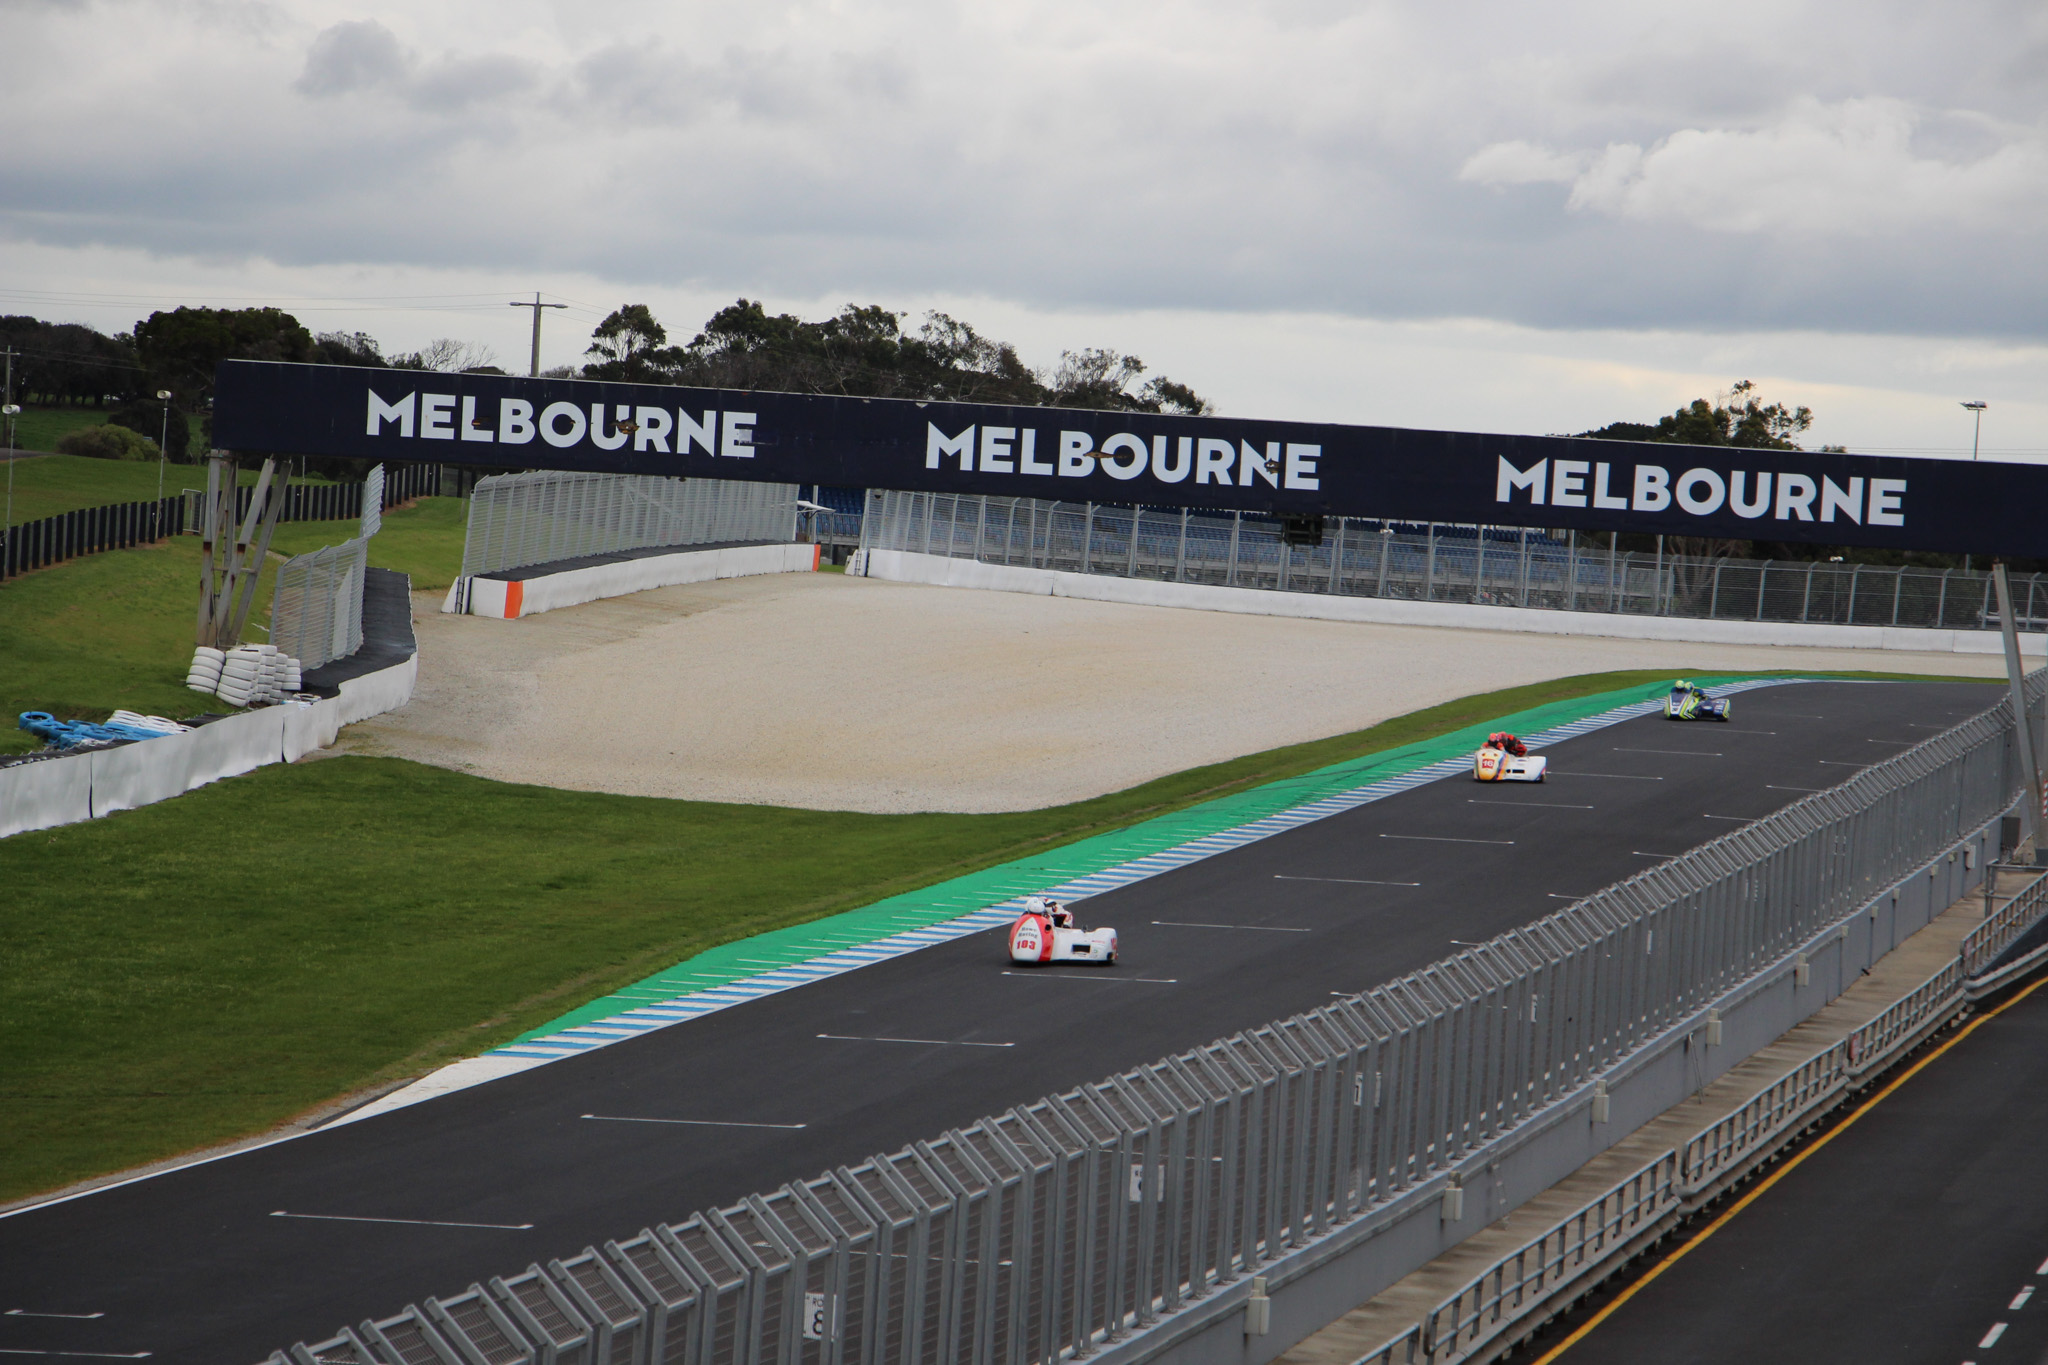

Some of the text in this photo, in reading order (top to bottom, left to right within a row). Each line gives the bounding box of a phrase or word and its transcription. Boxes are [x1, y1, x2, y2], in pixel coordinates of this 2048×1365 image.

[367, 389, 757, 458] MELBOURNE
[926, 422, 1322, 491] MELBOURNE
[1497, 455, 1906, 526] MELBOURNE
